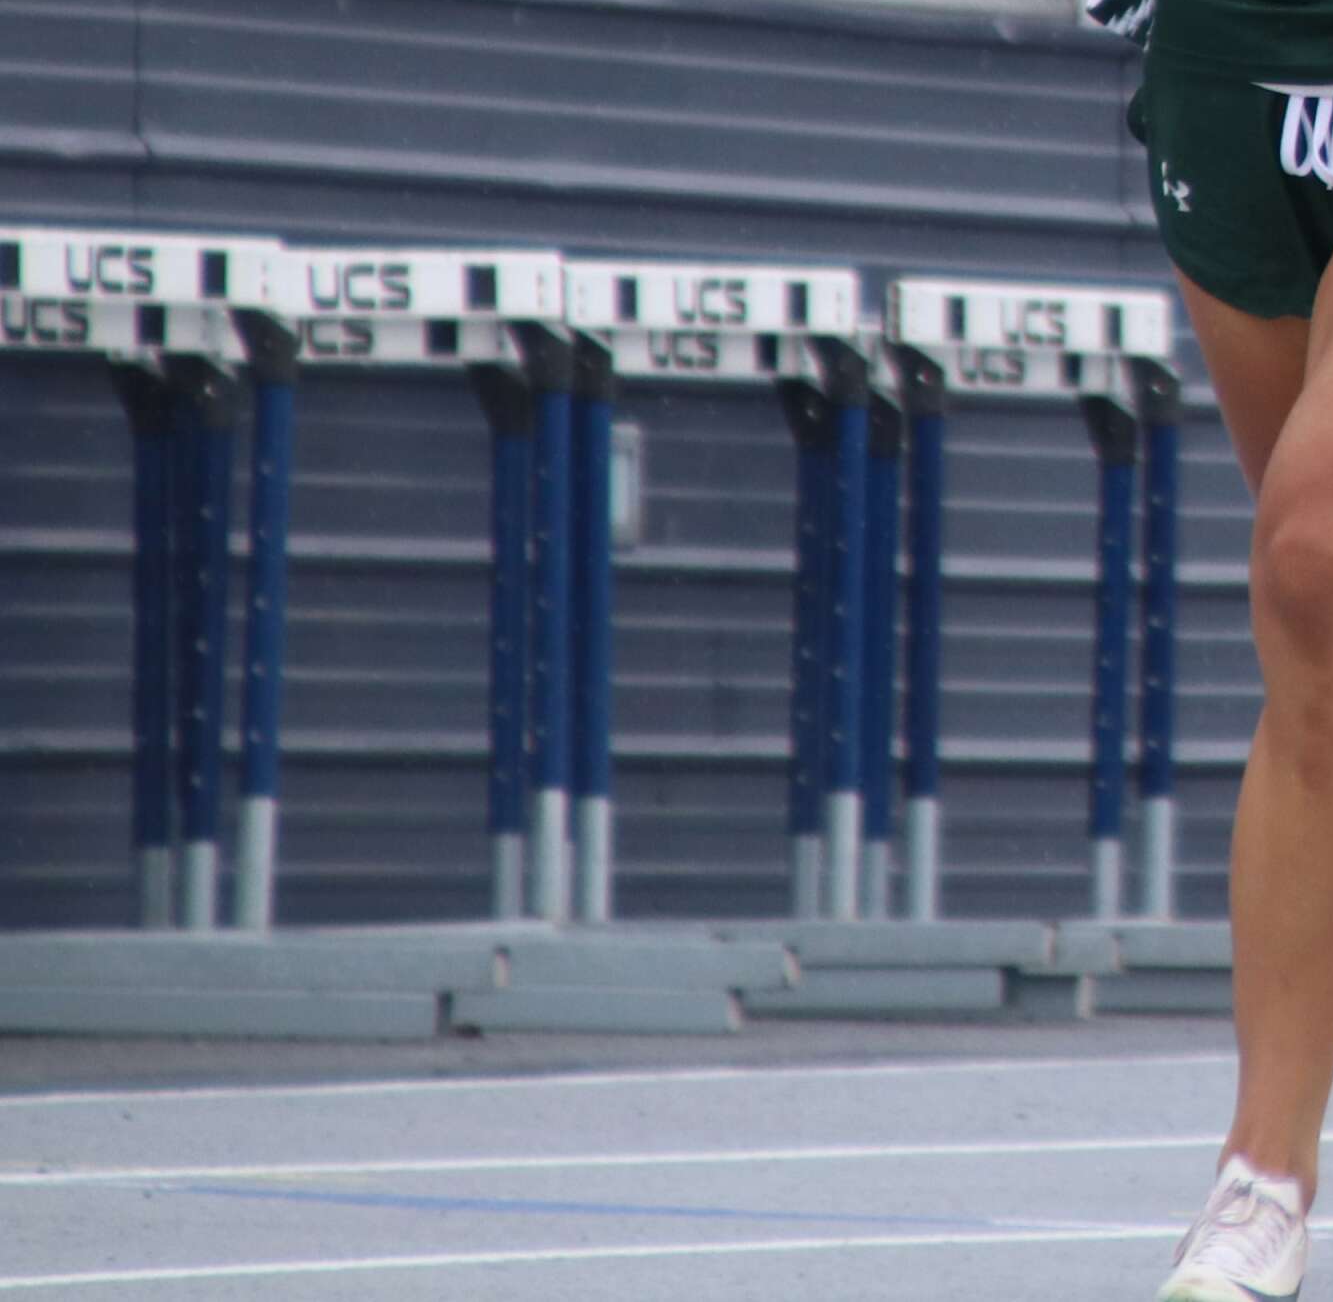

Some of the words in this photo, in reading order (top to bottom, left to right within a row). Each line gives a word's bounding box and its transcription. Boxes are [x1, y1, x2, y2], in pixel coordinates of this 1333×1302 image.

[65, 245, 154, 293] UCS
[307, 263, 411, 310] UCS
[1, 298, 88, 343] UCS
[673, 278, 746, 323] UCS
[298, 317, 373, 357] CS
[647, 329, 719, 370] UCS
